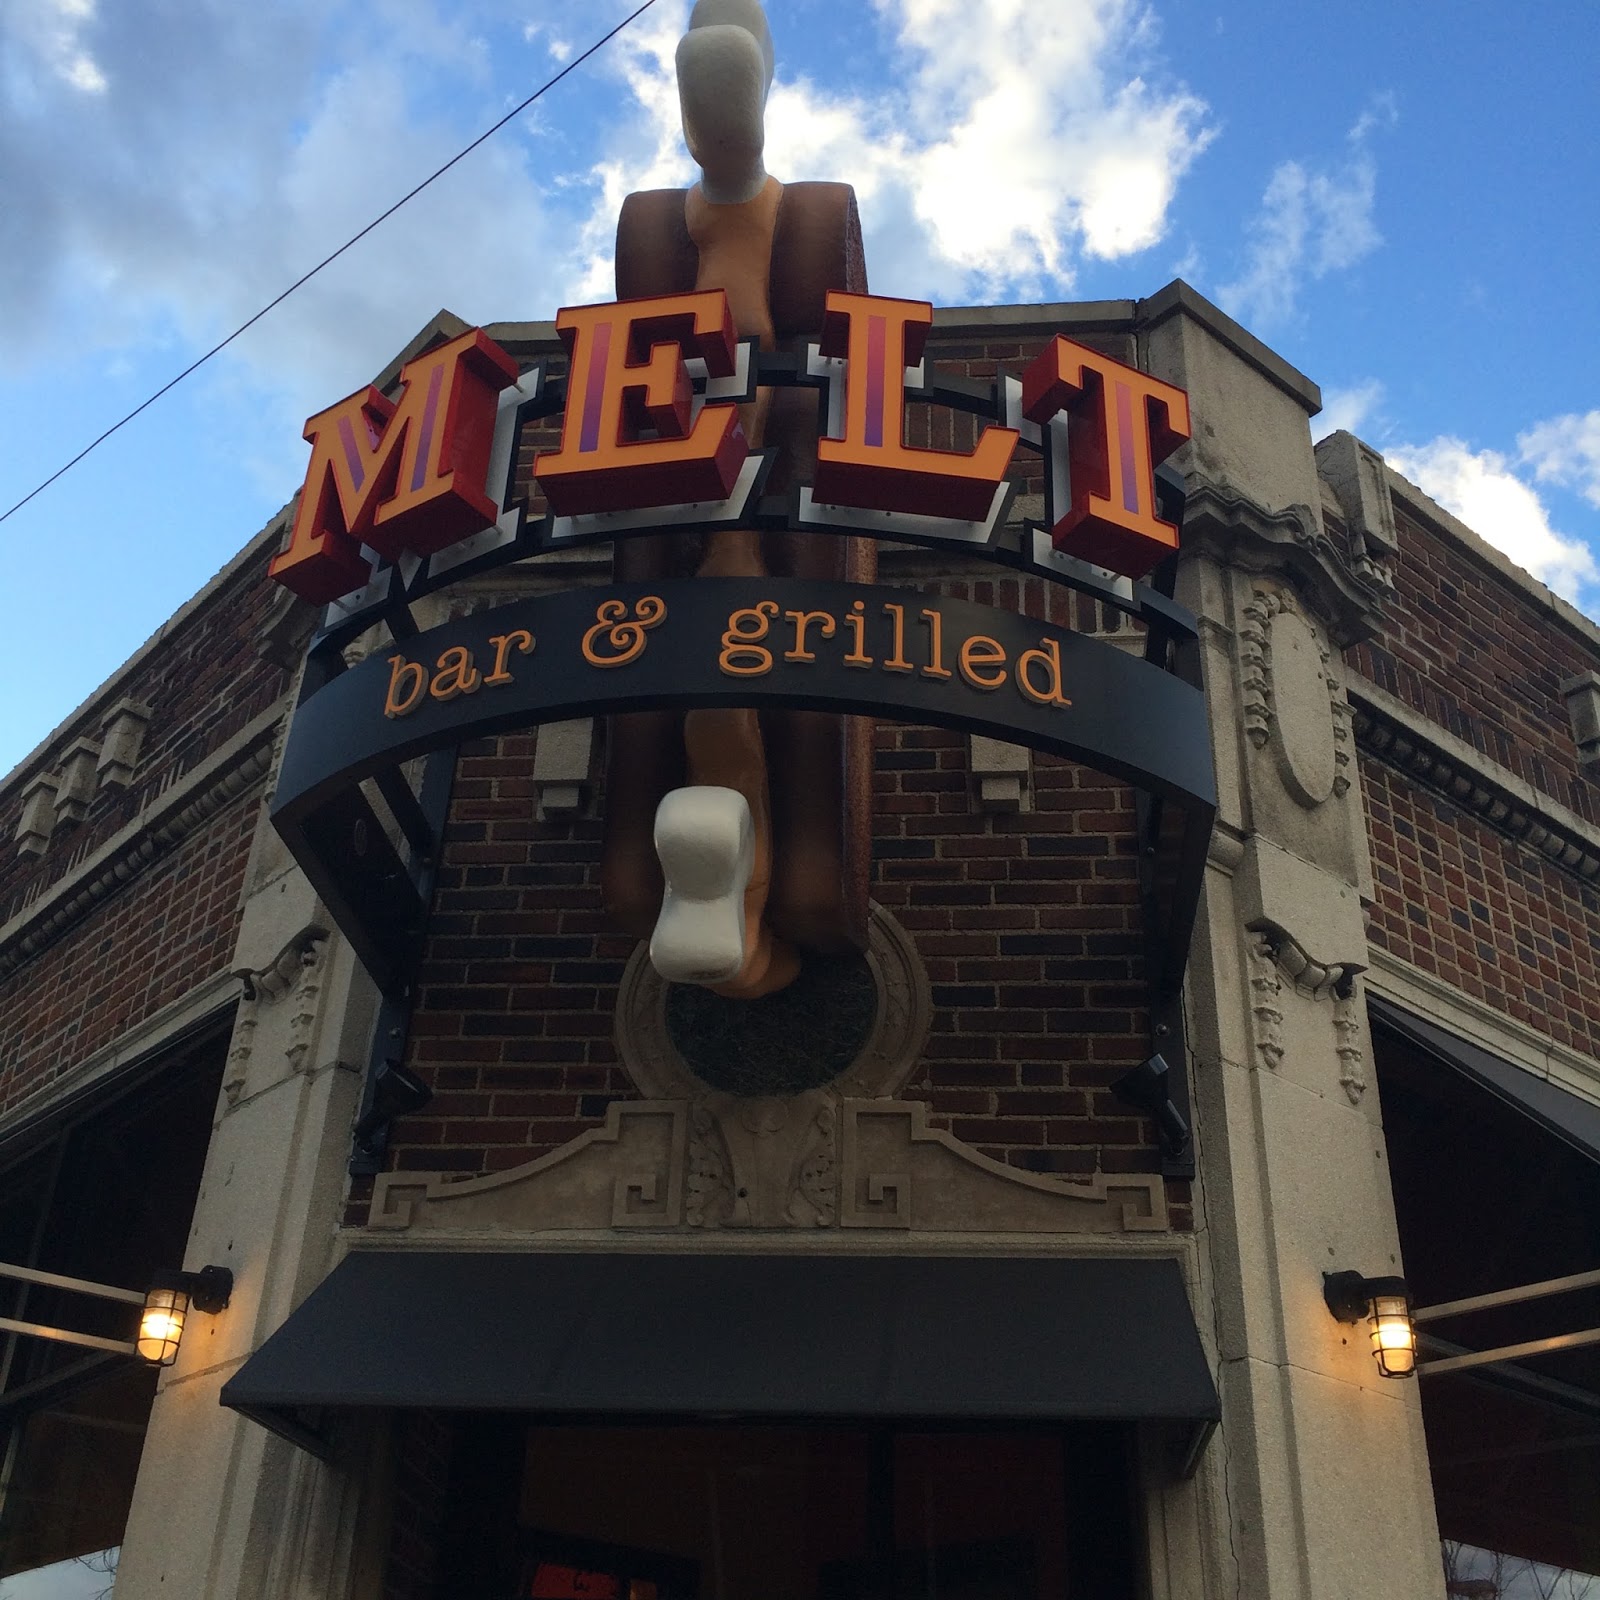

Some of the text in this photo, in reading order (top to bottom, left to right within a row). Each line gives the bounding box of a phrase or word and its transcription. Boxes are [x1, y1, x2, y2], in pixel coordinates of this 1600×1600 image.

[268, 288, 1191, 592] MELT
[383, 596, 1072, 719] bar & grilled
